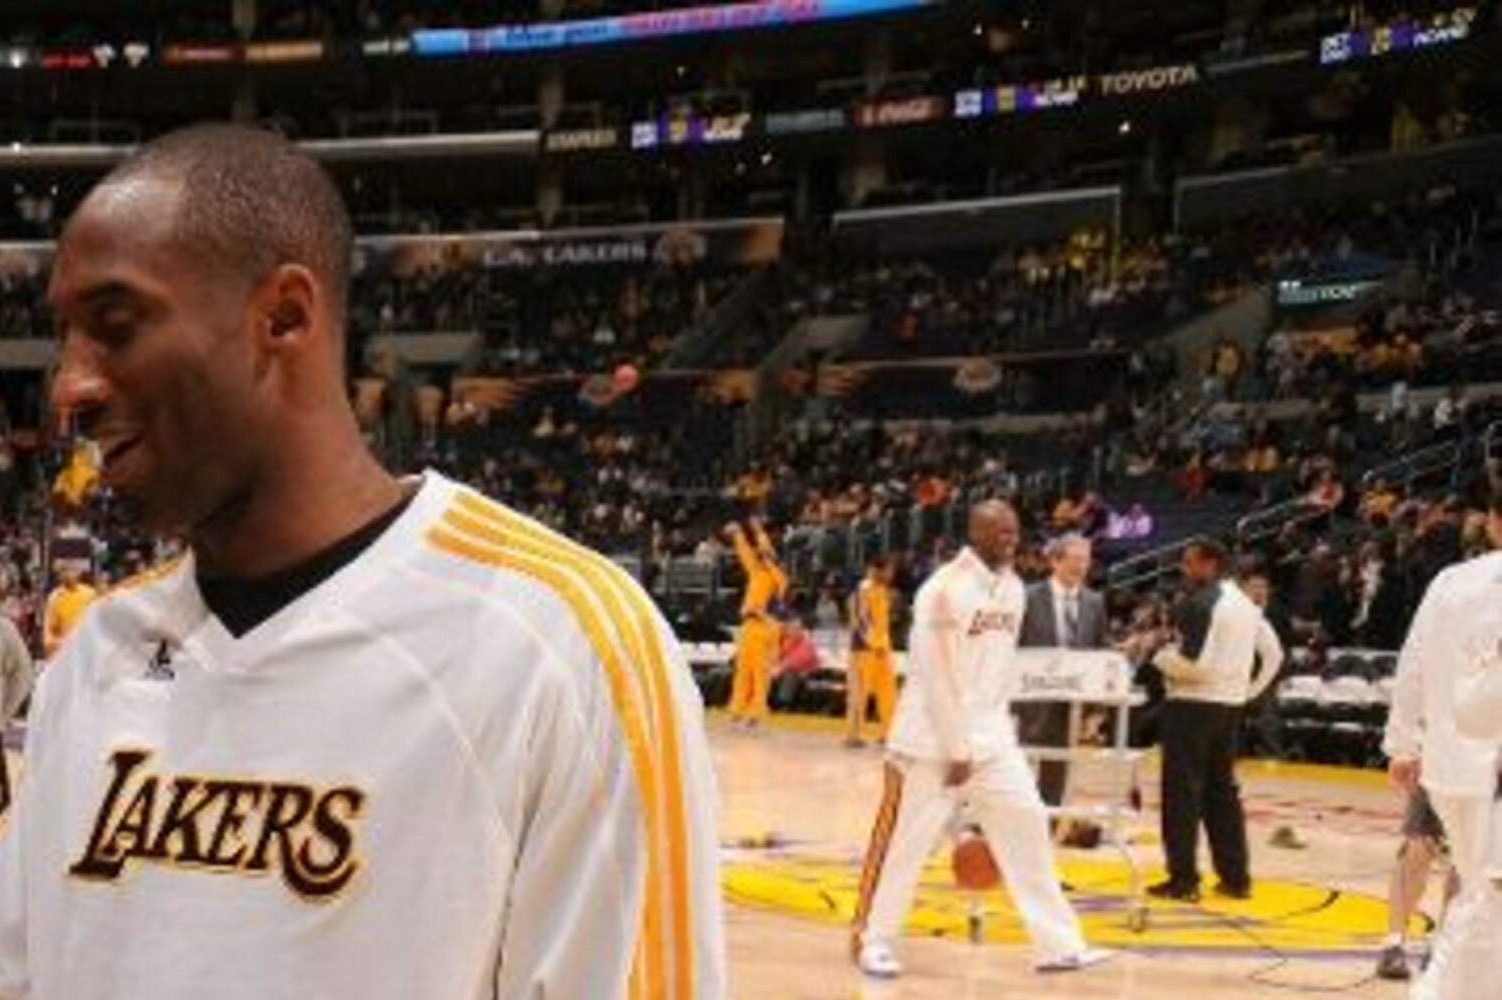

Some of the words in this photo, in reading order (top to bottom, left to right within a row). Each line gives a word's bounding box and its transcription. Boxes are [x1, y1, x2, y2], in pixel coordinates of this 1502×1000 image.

[1101, 65, 1197, 95] TOYOTA
[543, 242, 648, 266] LAKERS
[65, 745, 366, 904] LAKERS
